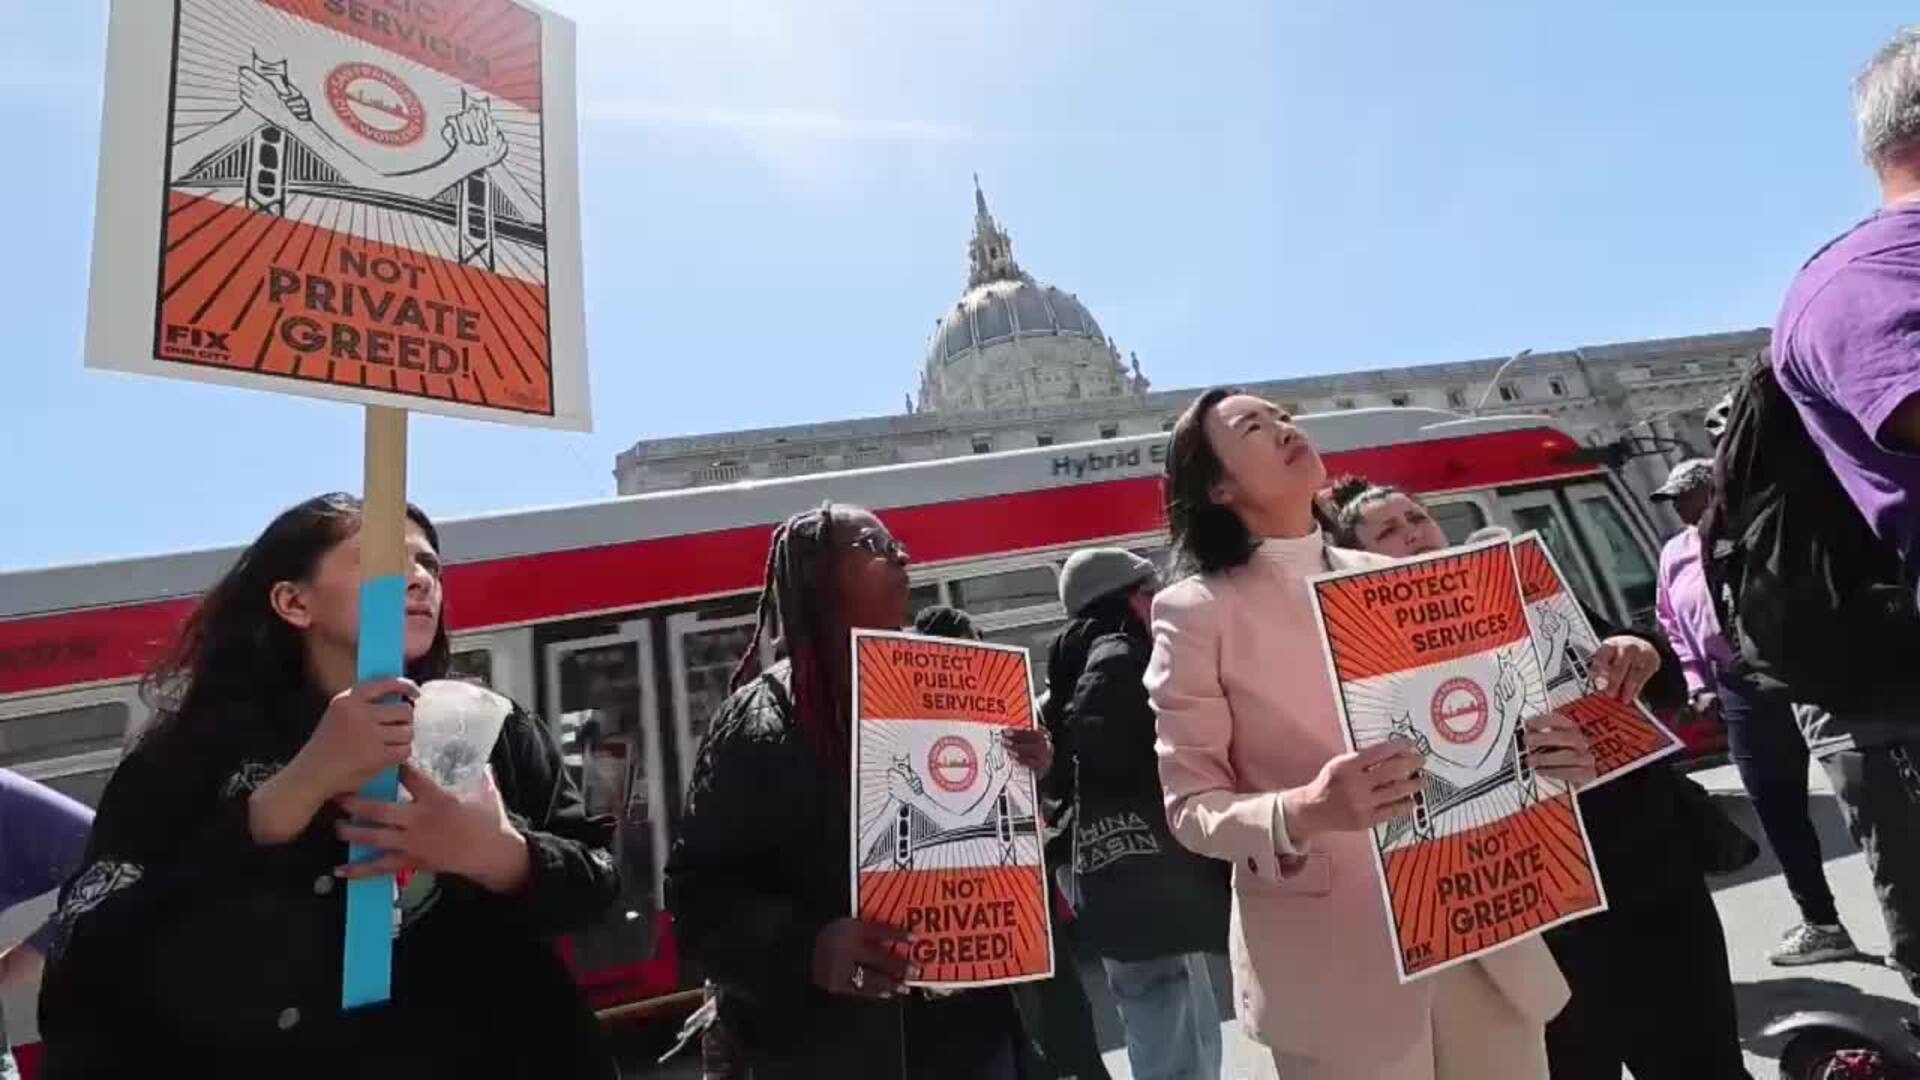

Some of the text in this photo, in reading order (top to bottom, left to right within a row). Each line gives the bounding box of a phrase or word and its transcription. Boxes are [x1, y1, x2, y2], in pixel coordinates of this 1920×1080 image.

[340, 247, 427, 290] NOT
[268, 265, 481, 342] PRIVATE
[166, 324, 230, 351] FIX
[280, 315, 470, 378] GREED!
[1052, 448, 1140, 478] Hybrid
[1363, 569, 1469, 609] PROTECT
[1395, 595, 1475, 629] PUBLIC
[1411, 612, 1508, 653] SERVICES
[892, 650, 973, 672] PROTECT
[913, 672, 977, 690] PUBLIC
[922, 692, 1006, 715] SERVICES
[1078, 811, 1151, 842] HINA
[1077, 833, 1159, 872] ASIN
[1466, 829, 1510, 864] NOT
[941, 877, 985, 900] NOT
[1437, 843, 1546, 906] PRIVATE
[906, 900, 1017, 933] PRIVATE
[1451, 876, 1547, 936] GREED!
[912, 931, 1014, 965] GREED!
[1406, 940, 1433, 962] FIX
